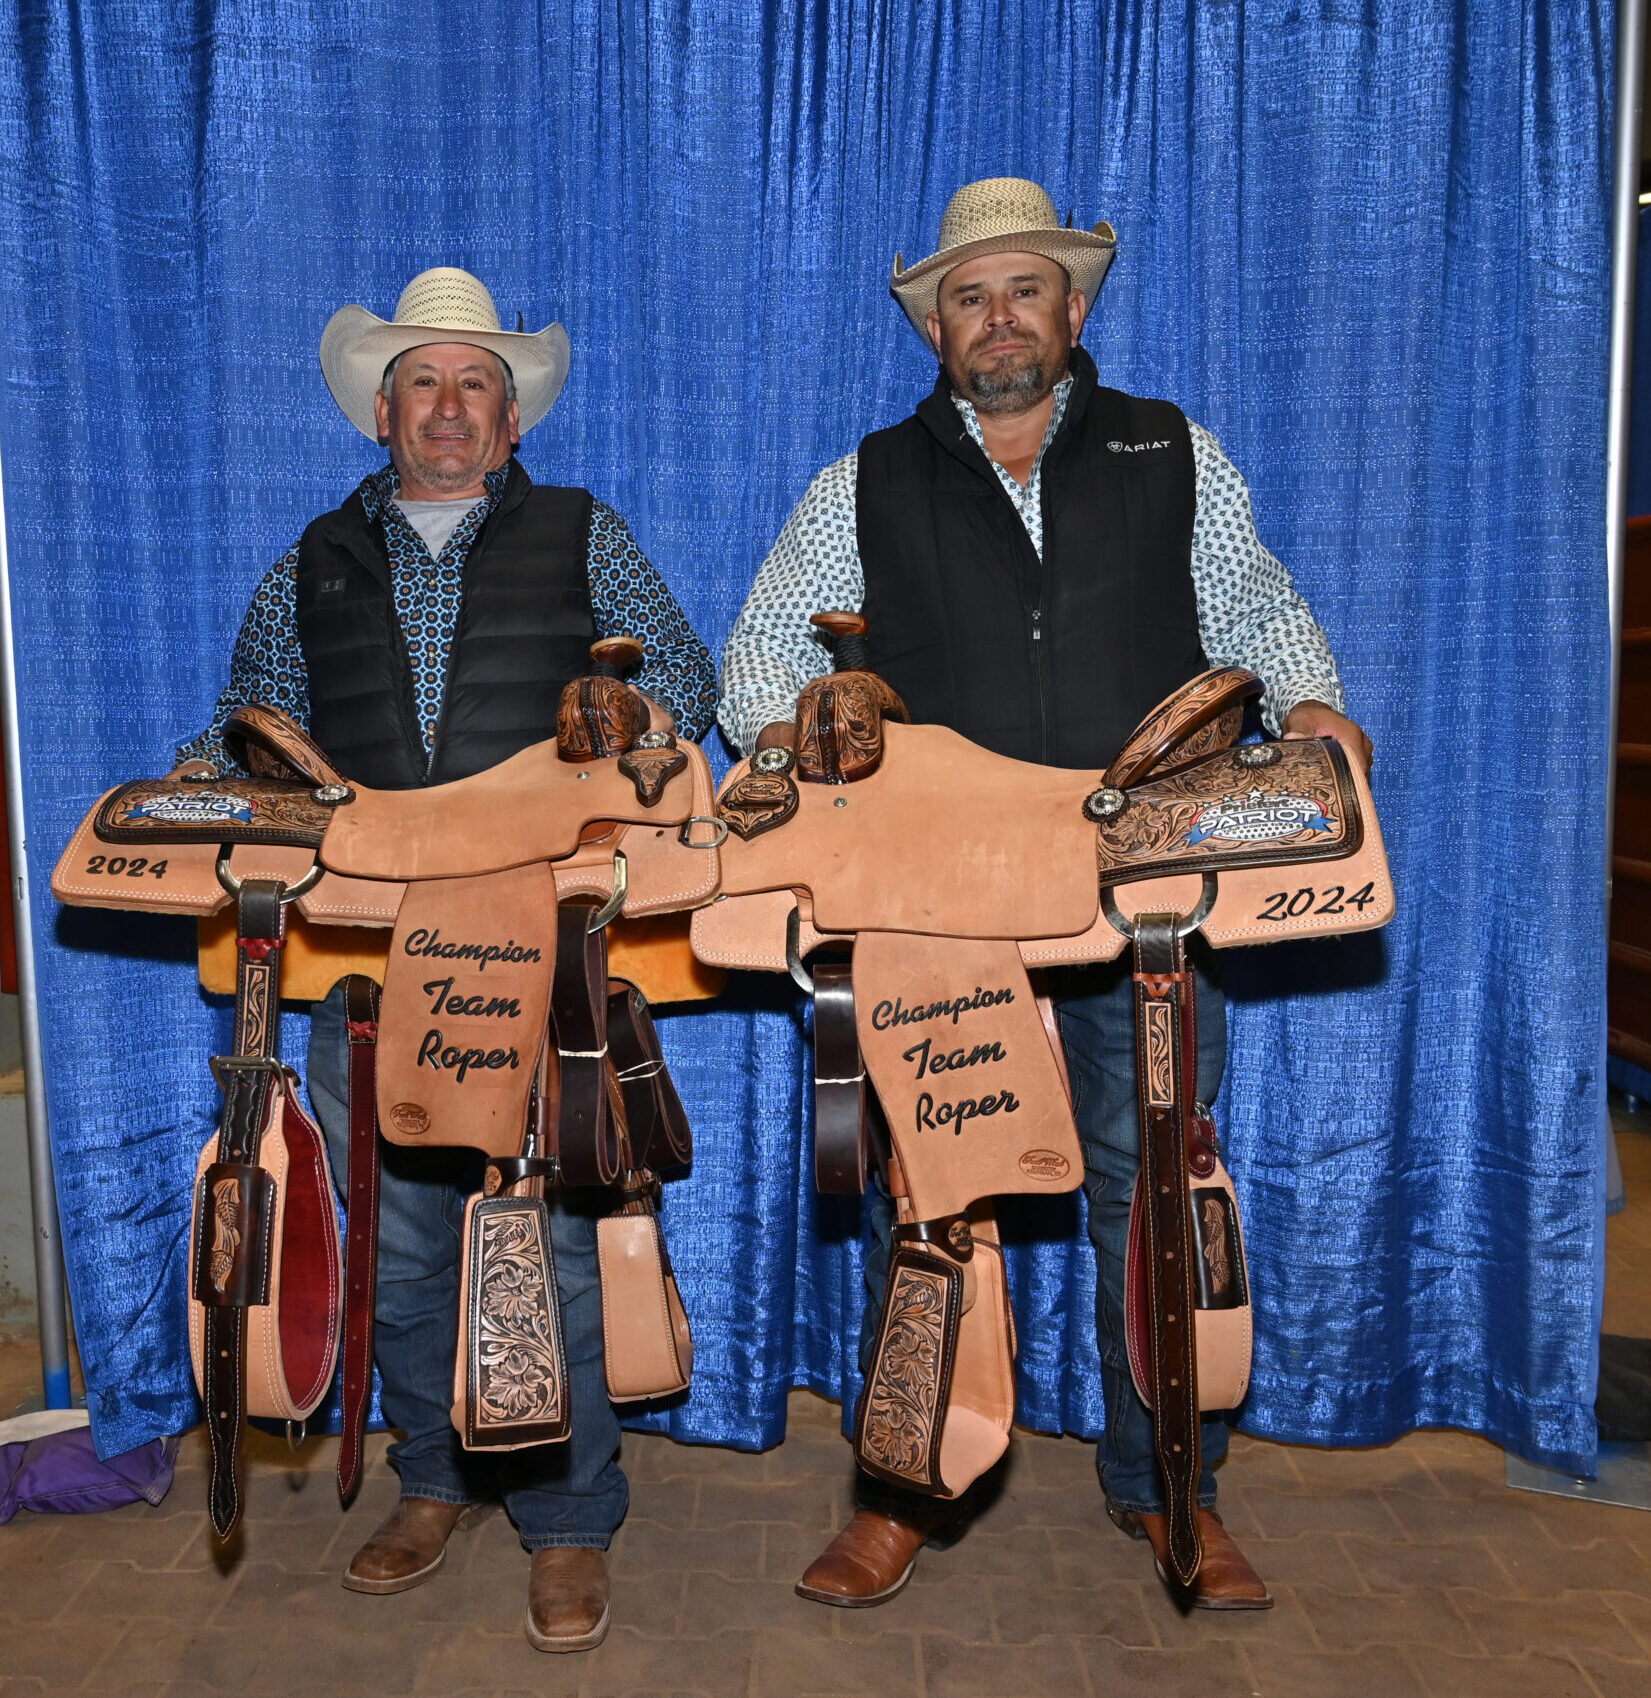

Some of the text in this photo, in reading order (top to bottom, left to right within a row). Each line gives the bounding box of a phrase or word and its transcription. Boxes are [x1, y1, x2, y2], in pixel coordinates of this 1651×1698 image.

[1124, 441, 1171, 452] ARIAT
[141, 801, 247, 814] PATRIOT
[1199, 809, 1318, 834] PATRIOT
[86, 855, 169, 879] 2024
[1257, 881, 1375, 922] 2024
[404, 928, 542, 971] Champion
[423, 976, 522, 1019] Team
[871, 986, 1015, 1031] Champion
[417, 1029, 520, 1083] Roper
[902, 1038, 1007, 1080] Team
[916, 1089, 1020, 1136] Roper
